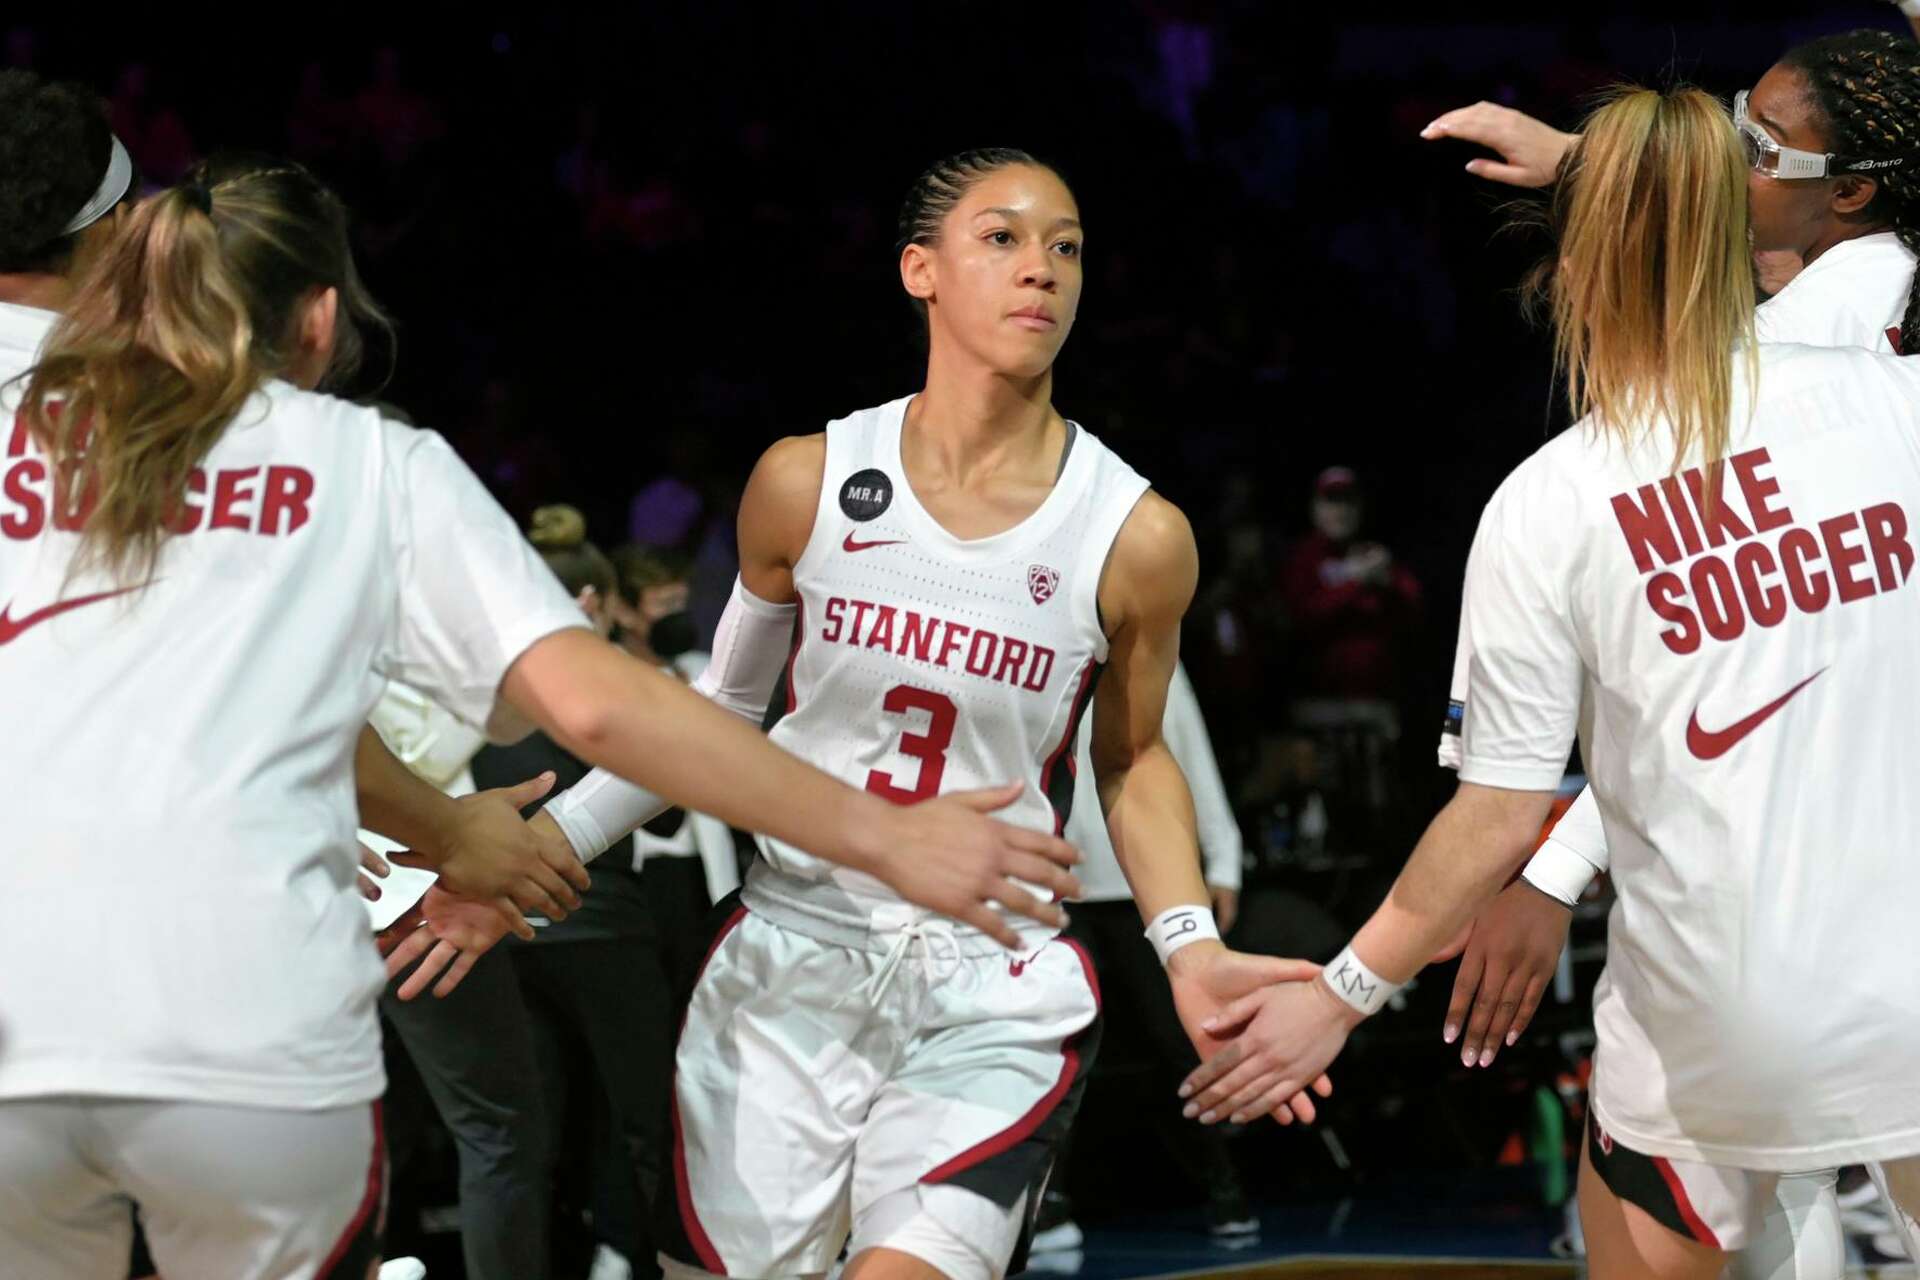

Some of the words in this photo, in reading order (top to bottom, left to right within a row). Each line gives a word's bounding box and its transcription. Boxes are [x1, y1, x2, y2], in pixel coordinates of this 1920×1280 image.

[0, 458, 315, 542] SOCER
[1610, 447, 1794, 575] NIKE
[1646, 502, 1915, 655] SOCCER
[822, 596, 1056, 693] STANFORD
[865, 684, 958, 806] 3
[1333, 960, 1377, 1004] KM
